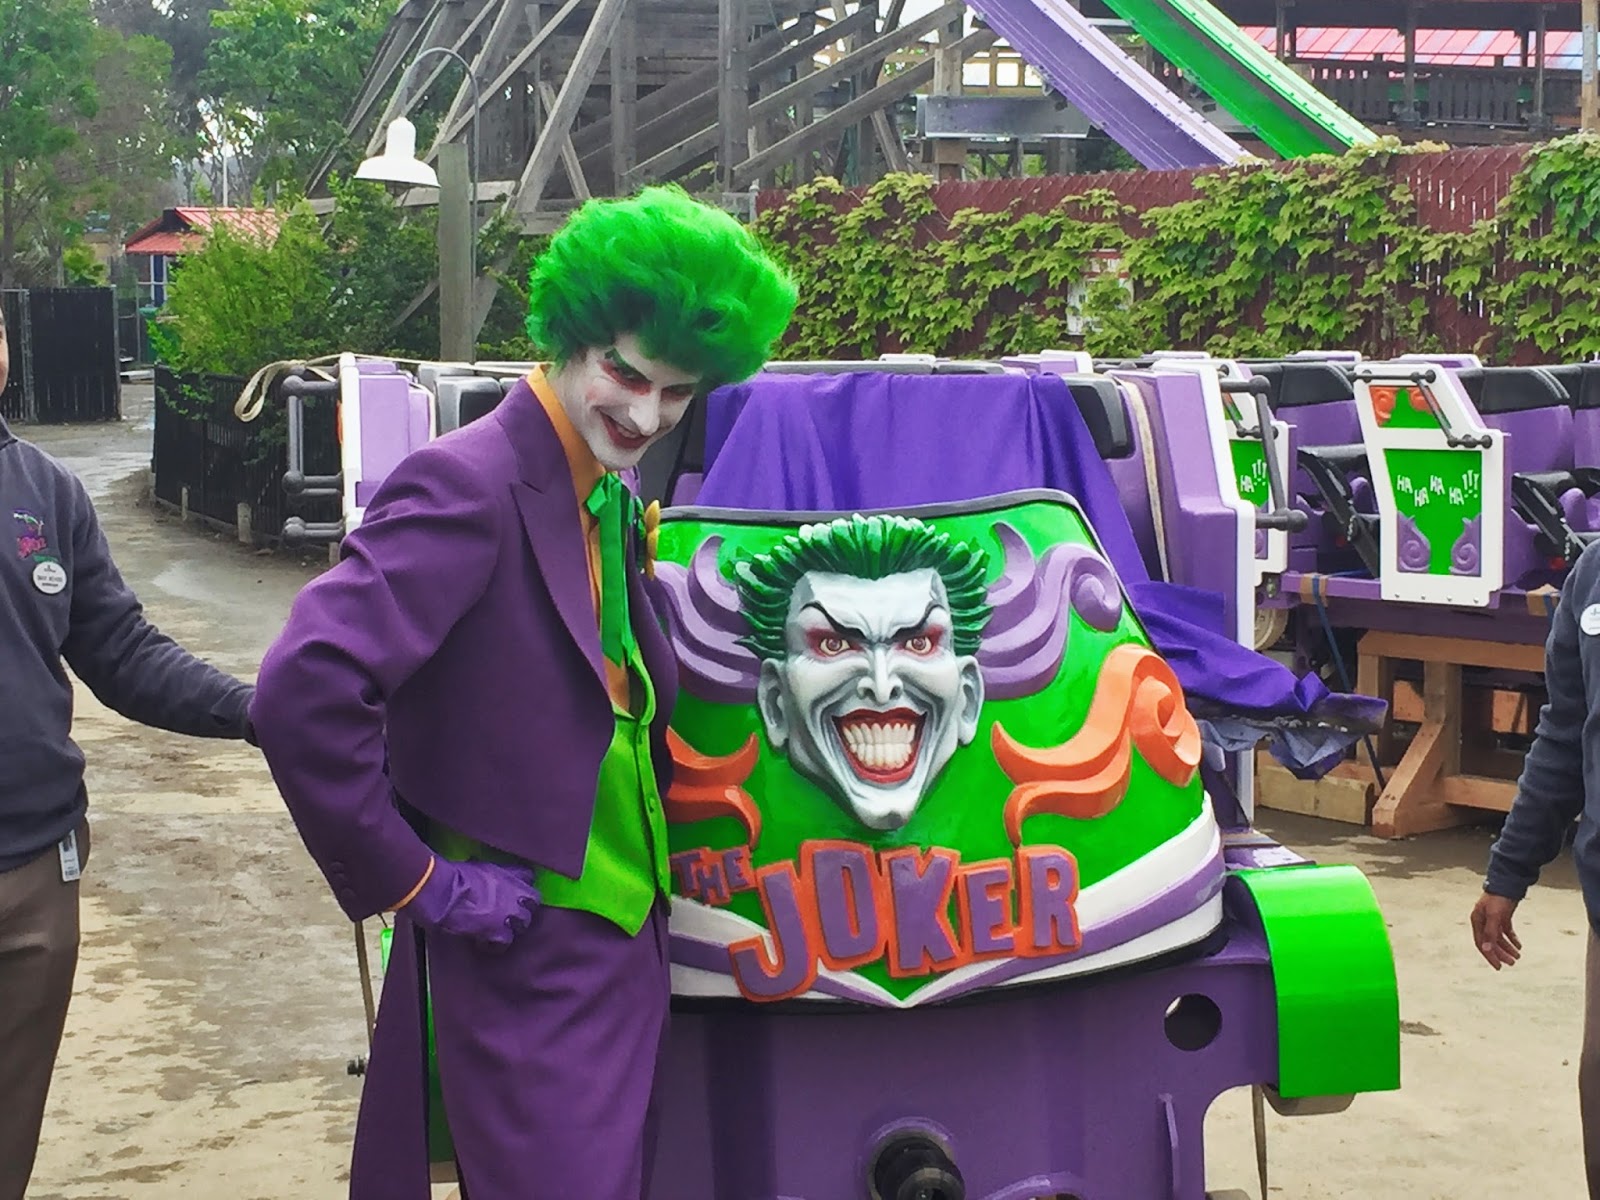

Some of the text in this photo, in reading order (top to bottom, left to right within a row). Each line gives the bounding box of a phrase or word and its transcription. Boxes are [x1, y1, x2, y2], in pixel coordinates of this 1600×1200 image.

[1397, 474, 1413, 494] HA
[1414, 487, 1430, 507] HA
[1430, 475, 1446, 495] HA
[670, 846, 755, 904] THE
[729, 840, 1082, 1001] JOKER
